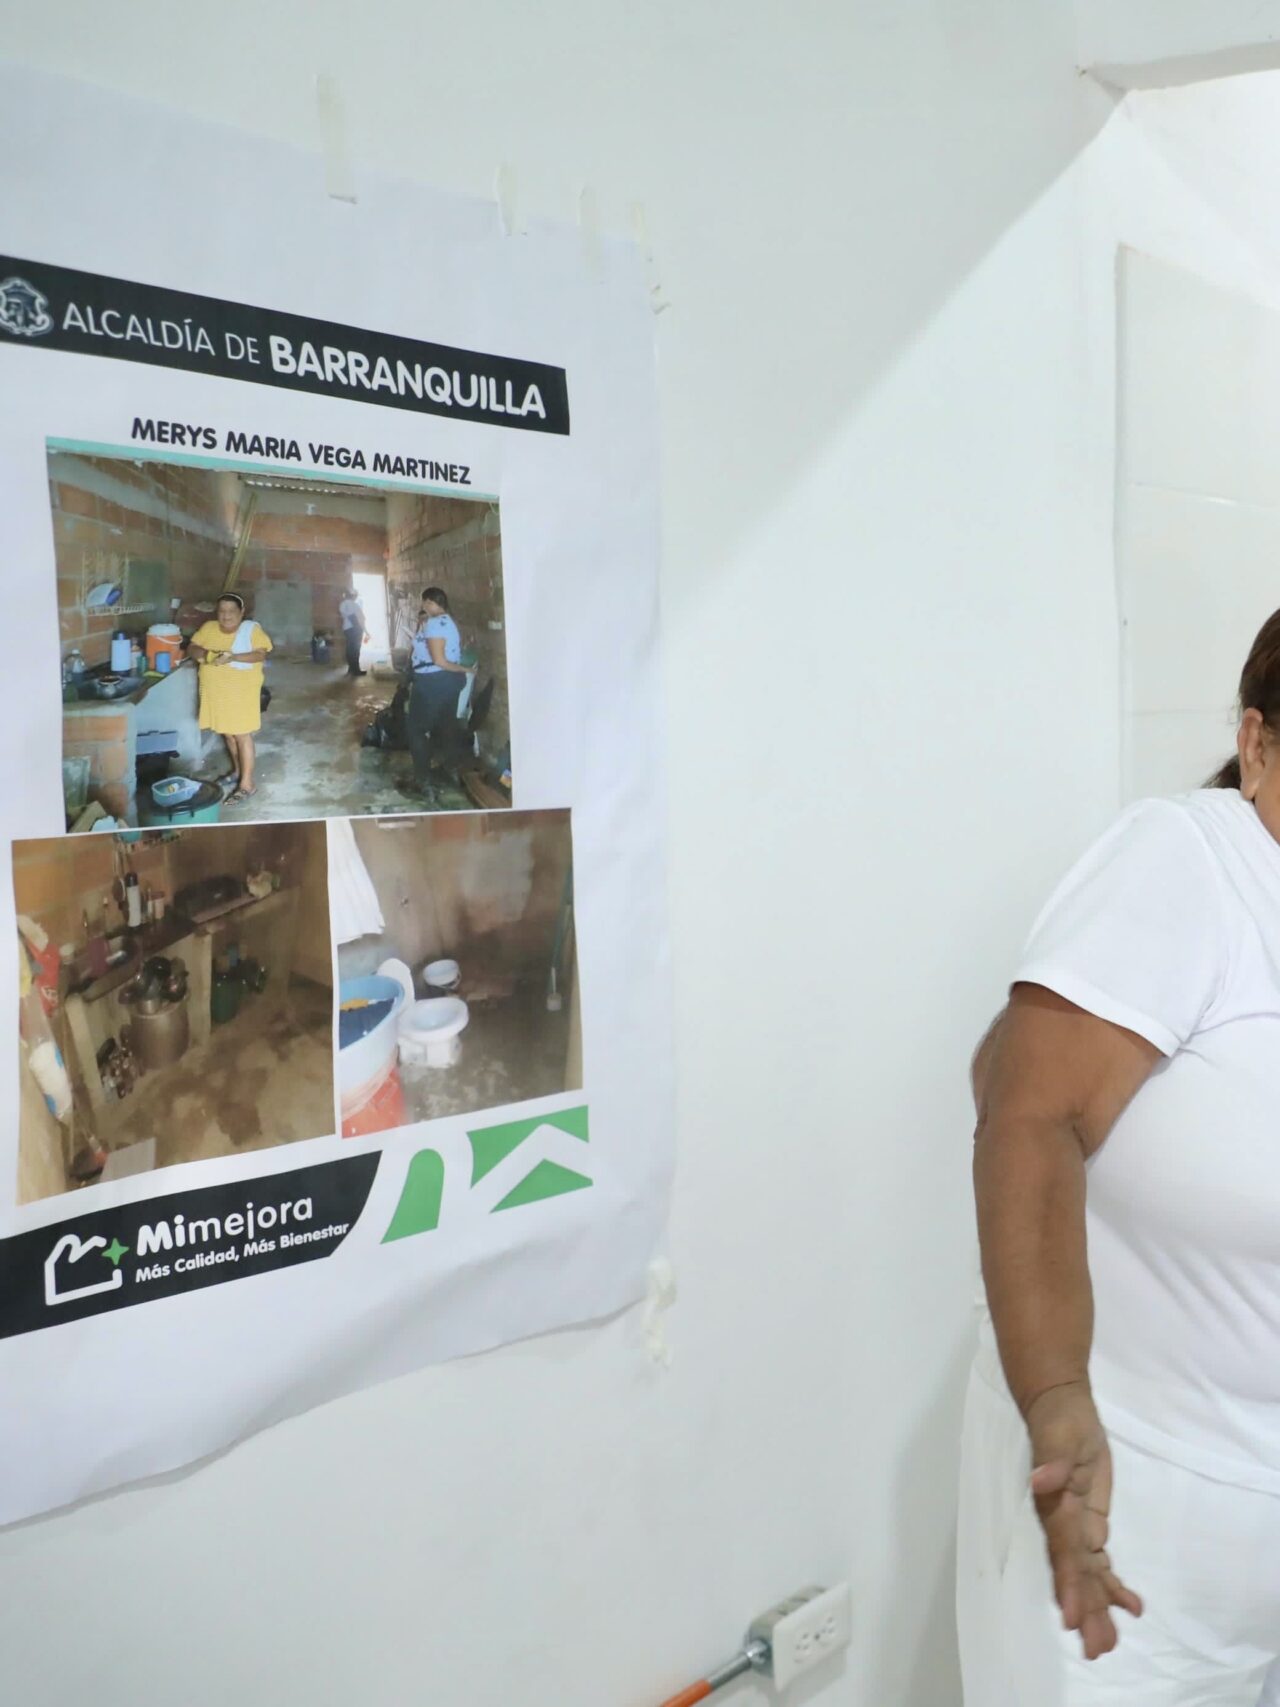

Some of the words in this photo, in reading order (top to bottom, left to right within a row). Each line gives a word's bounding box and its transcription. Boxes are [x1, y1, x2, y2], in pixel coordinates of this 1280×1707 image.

[62, 302, 216, 357] ALCALDÍA
[226, 332, 261, 364] DE
[269, 335, 547, 419] BARRANQUILLA
[131, 417, 217, 450] MERYS
[225, 432, 301, 462] MARIA
[308, 442, 366, 470] VEGA
[373, 453, 471, 485] MARTINEZ
[135, 1262, 171, 1283] Más
[175, 1246, 241, 1275] Calidad,
[243, 1239, 277, 1259] Más
[280, 1221, 350, 1250] Bienestar
[136, 1196, 313, 1257] Mimejora
